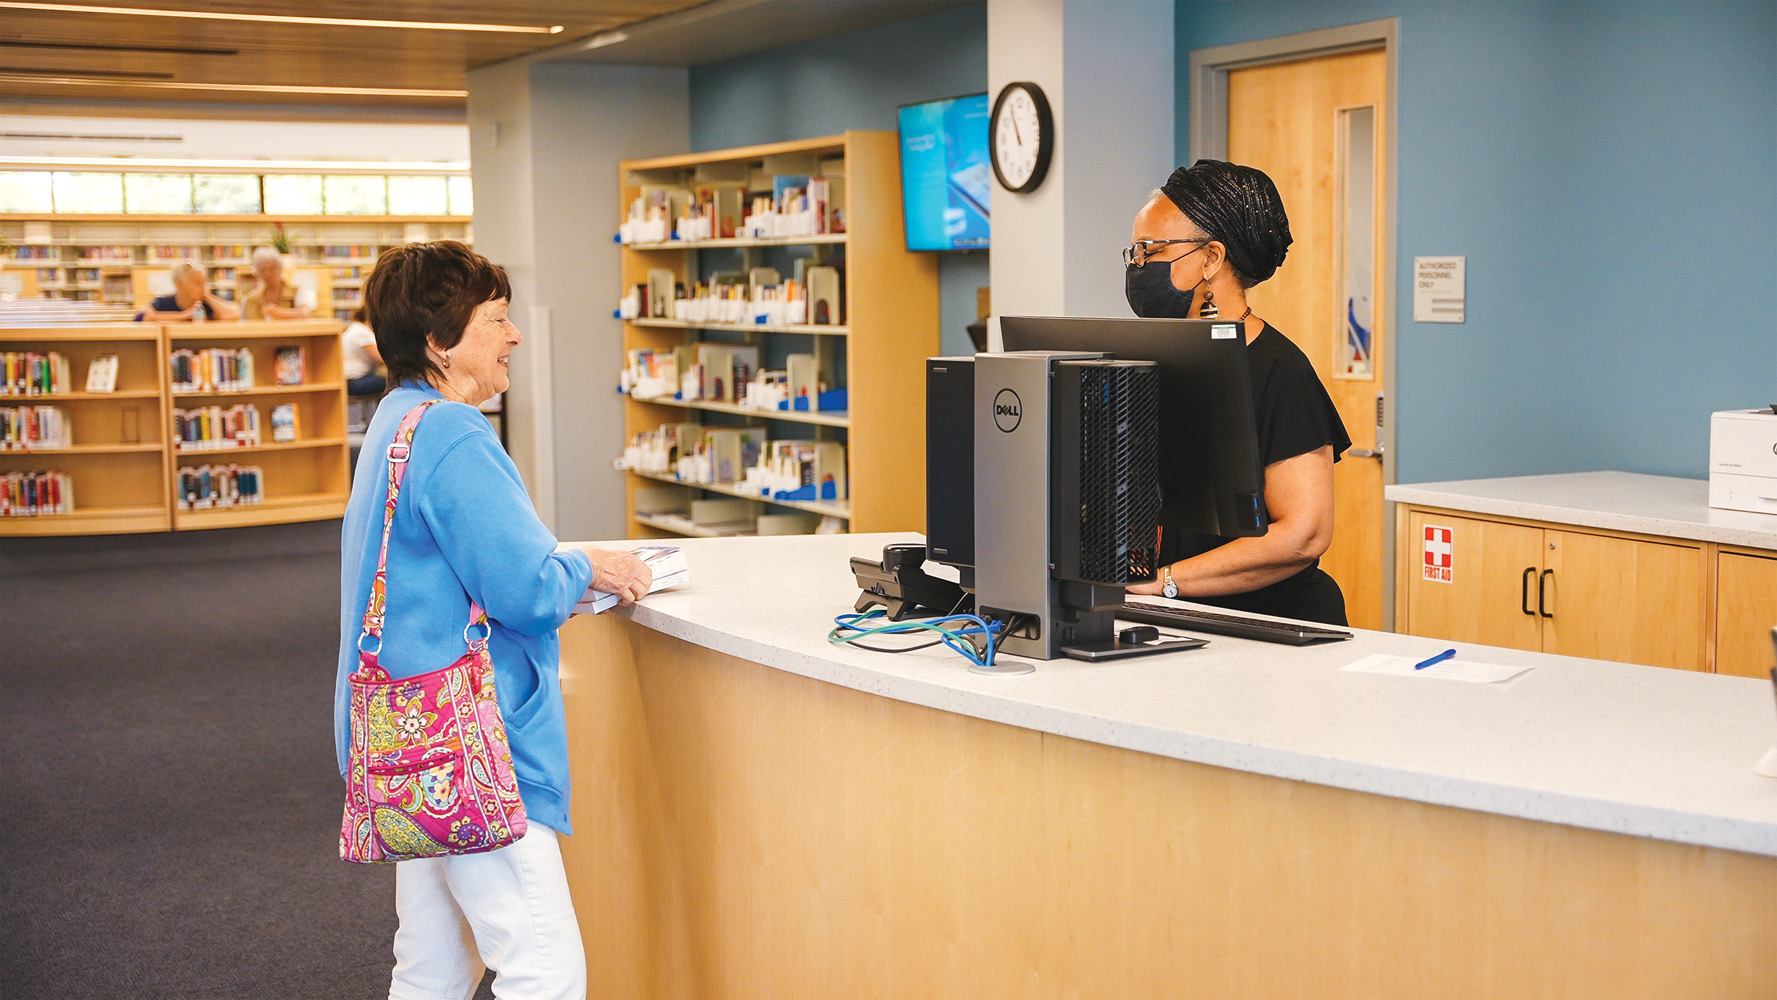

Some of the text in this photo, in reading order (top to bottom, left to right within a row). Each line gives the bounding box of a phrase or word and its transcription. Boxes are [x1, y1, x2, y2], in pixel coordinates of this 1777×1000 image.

[1419, 262, 1457, 270] AUTHORIZED
[1419, 271, 1453, 279] PERSONNEL
[1419, 281, 1434, 289] ONLY
[996, 404, 1019, 417] DELL
[1425, 566, 1451, 582] FIRST AID
